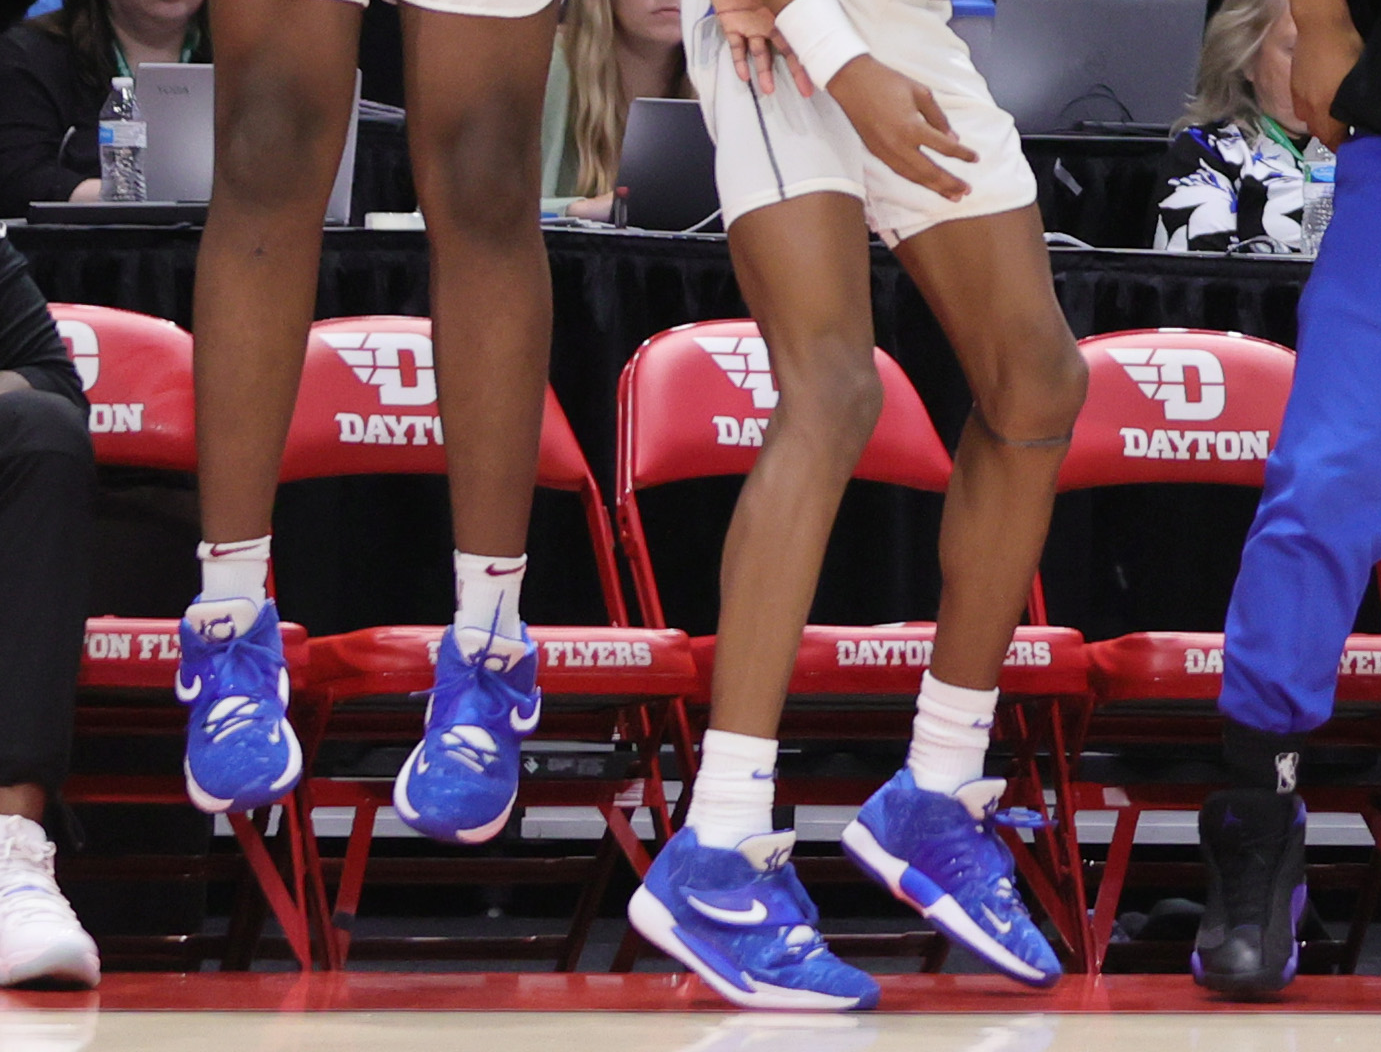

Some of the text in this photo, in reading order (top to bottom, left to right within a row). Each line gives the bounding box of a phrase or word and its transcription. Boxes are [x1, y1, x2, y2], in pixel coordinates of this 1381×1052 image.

[334, 412, 445, 446] DAYT
[1119, 427, 1271, 461] DAYTON
[544, 641, 653, 667] FLYERS
